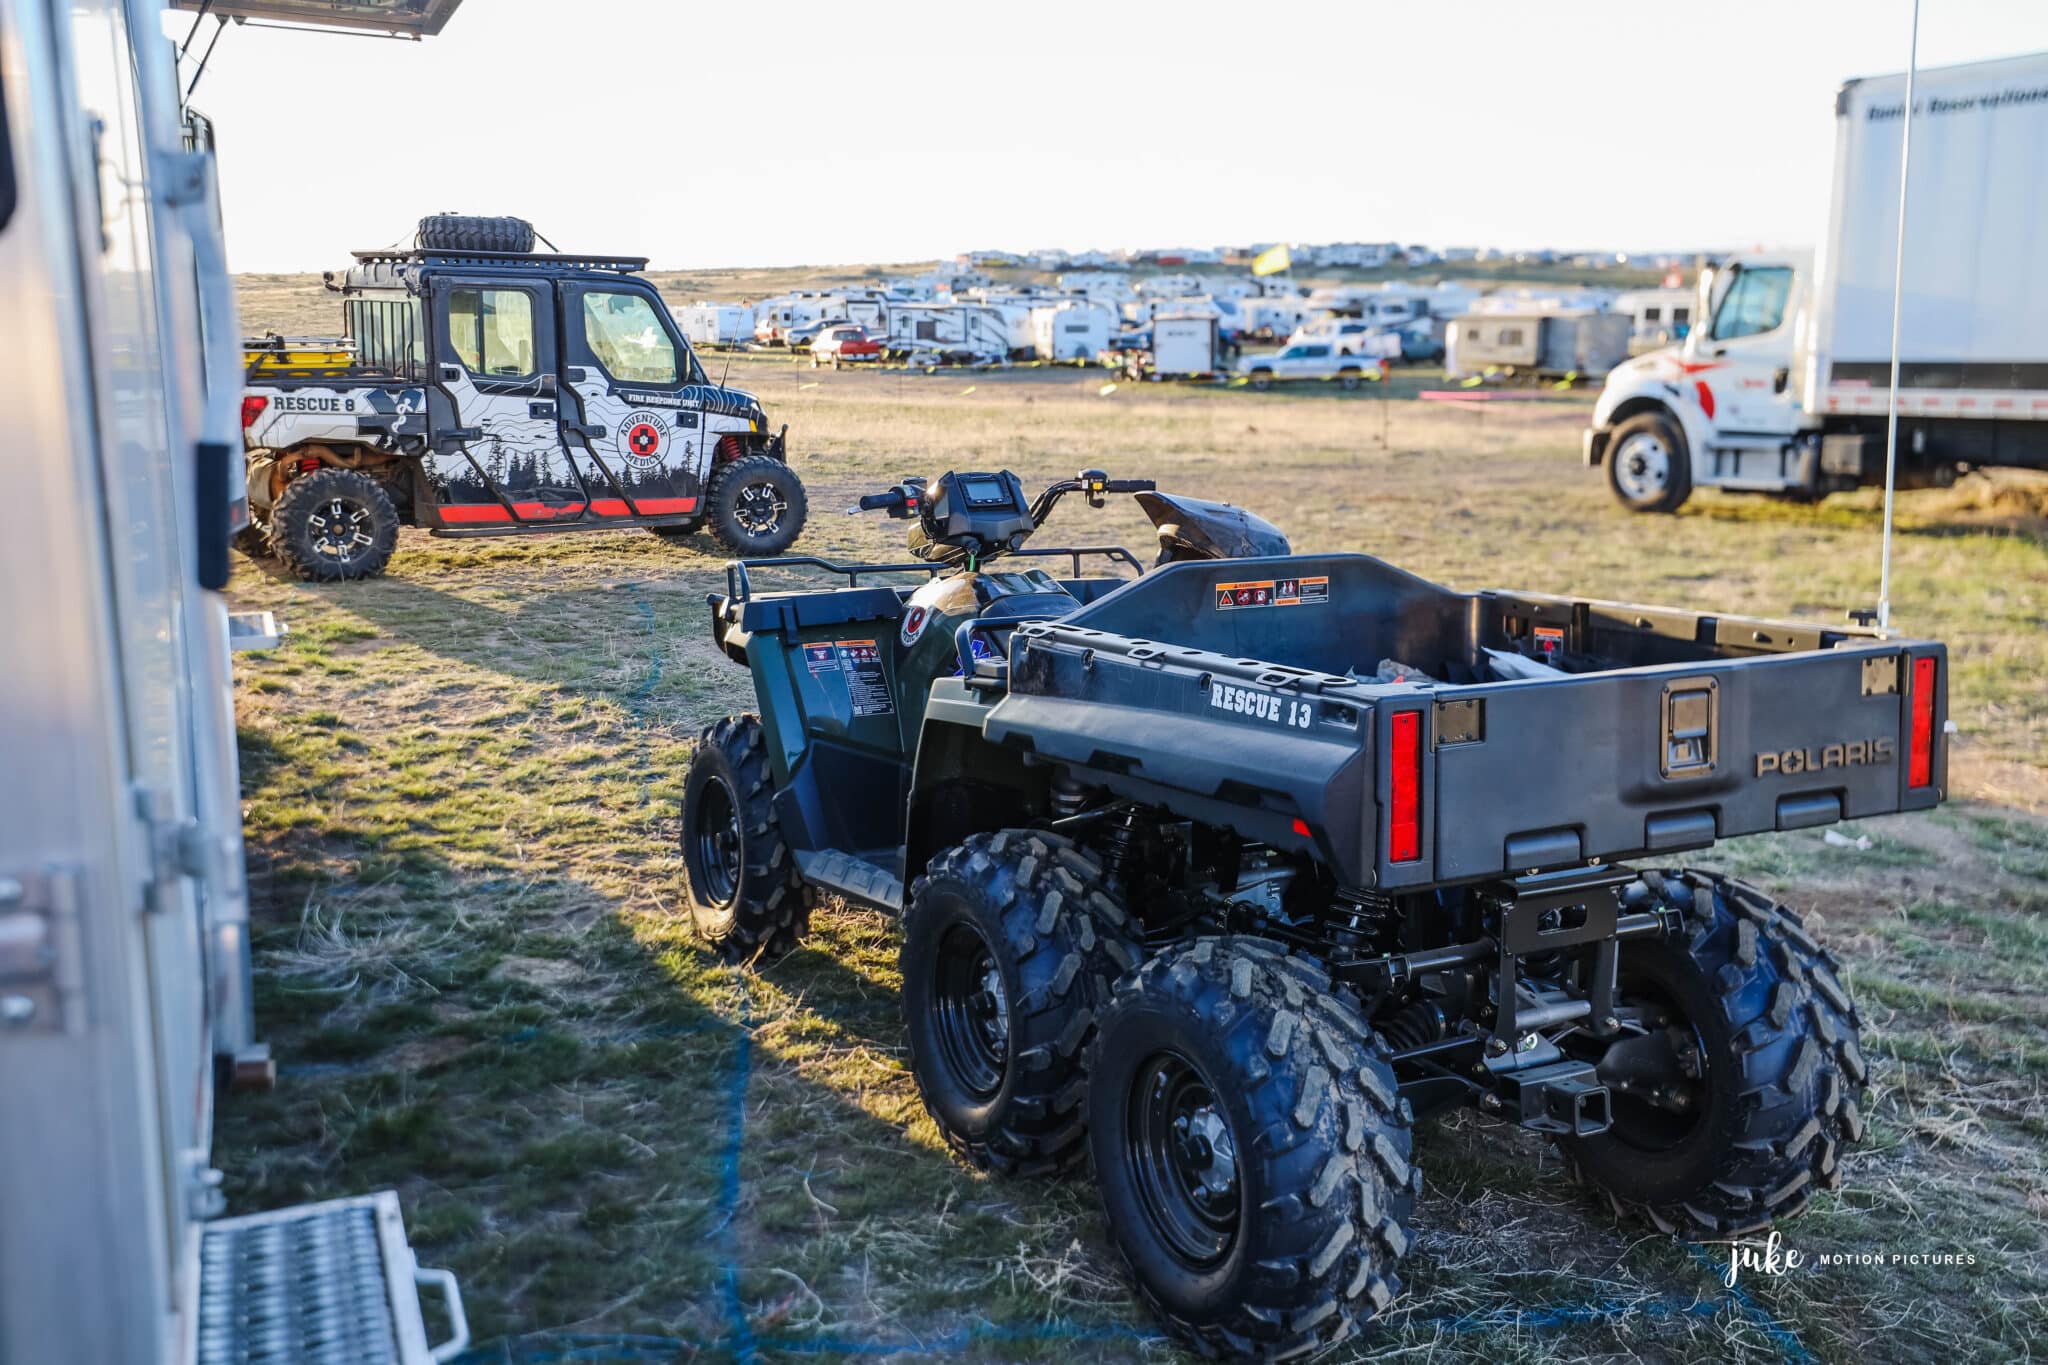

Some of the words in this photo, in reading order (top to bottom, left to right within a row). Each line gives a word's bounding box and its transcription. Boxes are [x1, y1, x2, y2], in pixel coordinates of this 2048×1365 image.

[274, 397, 340, 411] RESCUE
[345, 399, 355, 411] 8
[628, 393, 645, 402] FIRE
[646, 395, 681, 406] RESPONSE
[682, 398, 700, 408] UNIT
[620, 413, 667, 438] ADVENTURE
[625, 451, 661, 467] MEDICS
[1211, 683, 1281, 722] RESCUE
[1288, 701, 1312, 728] 13
[1756, 736, 1895, 778] POLARIS
